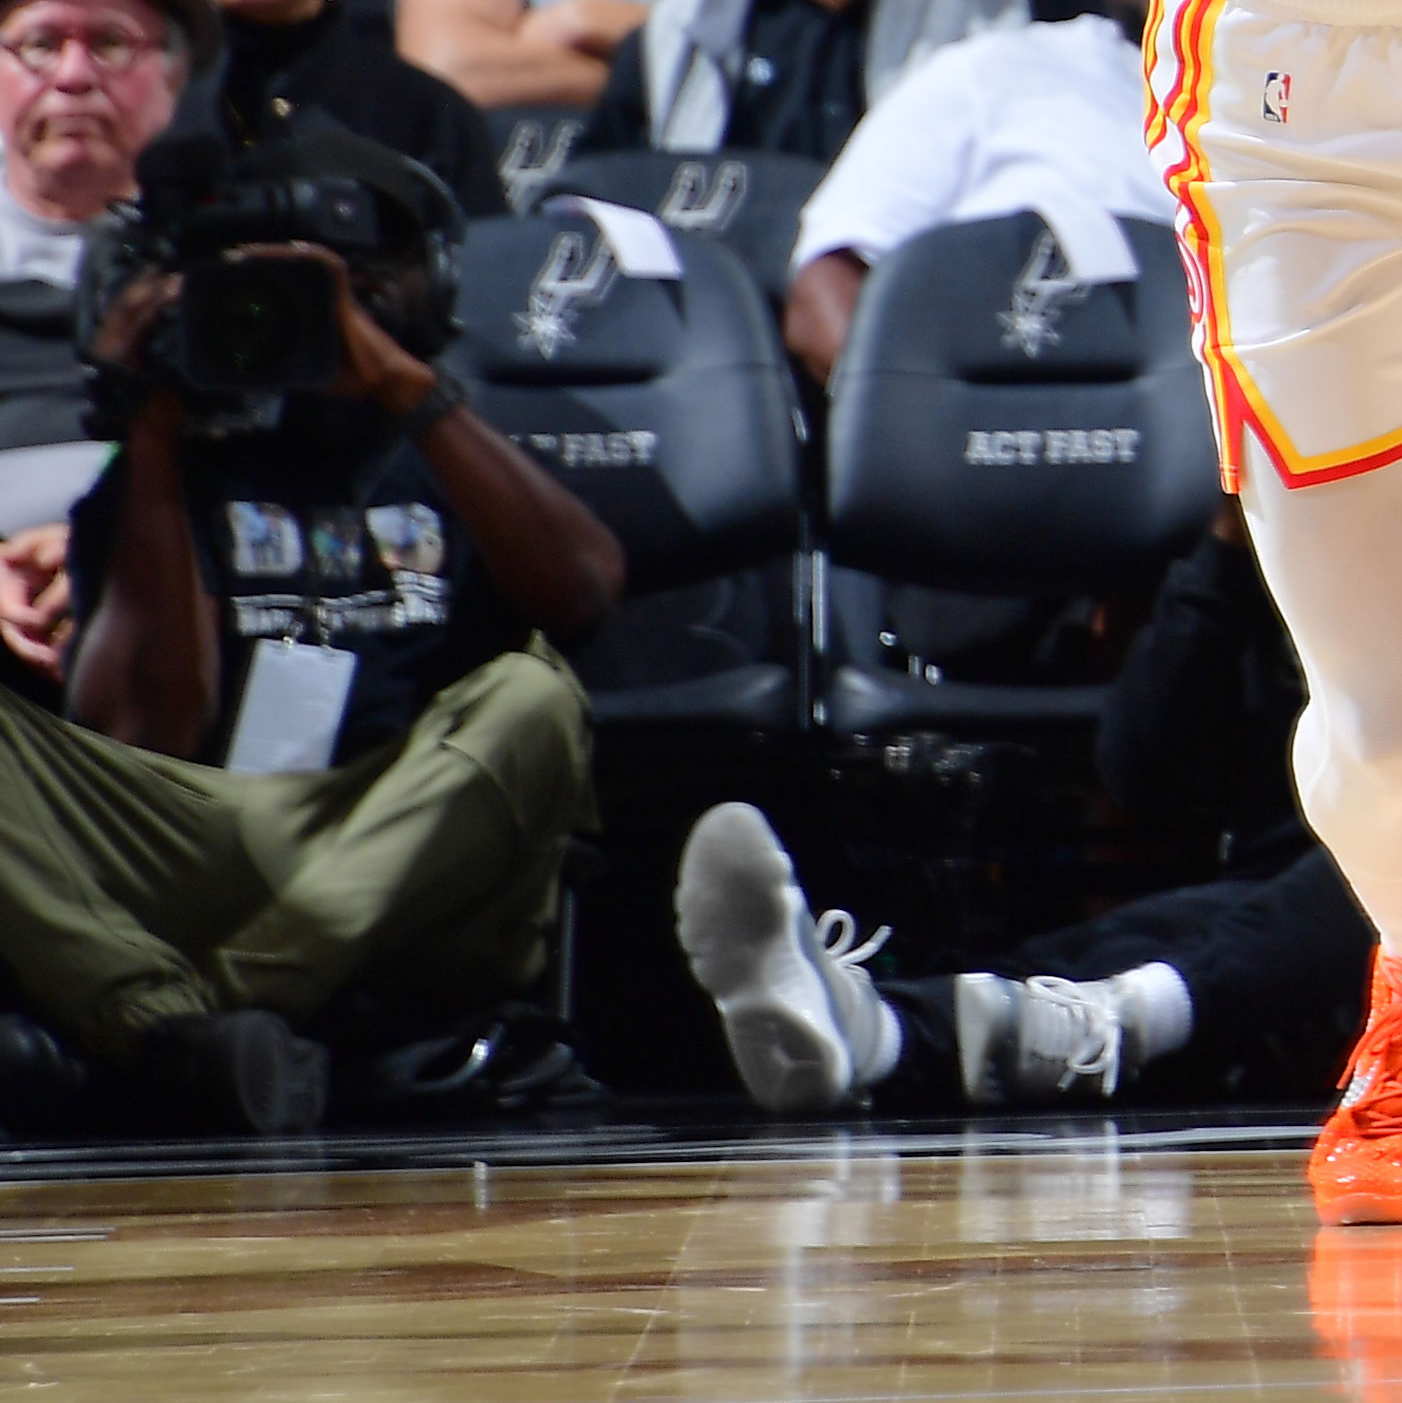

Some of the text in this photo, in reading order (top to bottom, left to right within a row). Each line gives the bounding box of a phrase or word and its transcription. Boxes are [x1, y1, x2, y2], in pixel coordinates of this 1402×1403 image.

[562, 431, 657, 467] FAST
[964, 428, 1140, 466] ACT FAST
